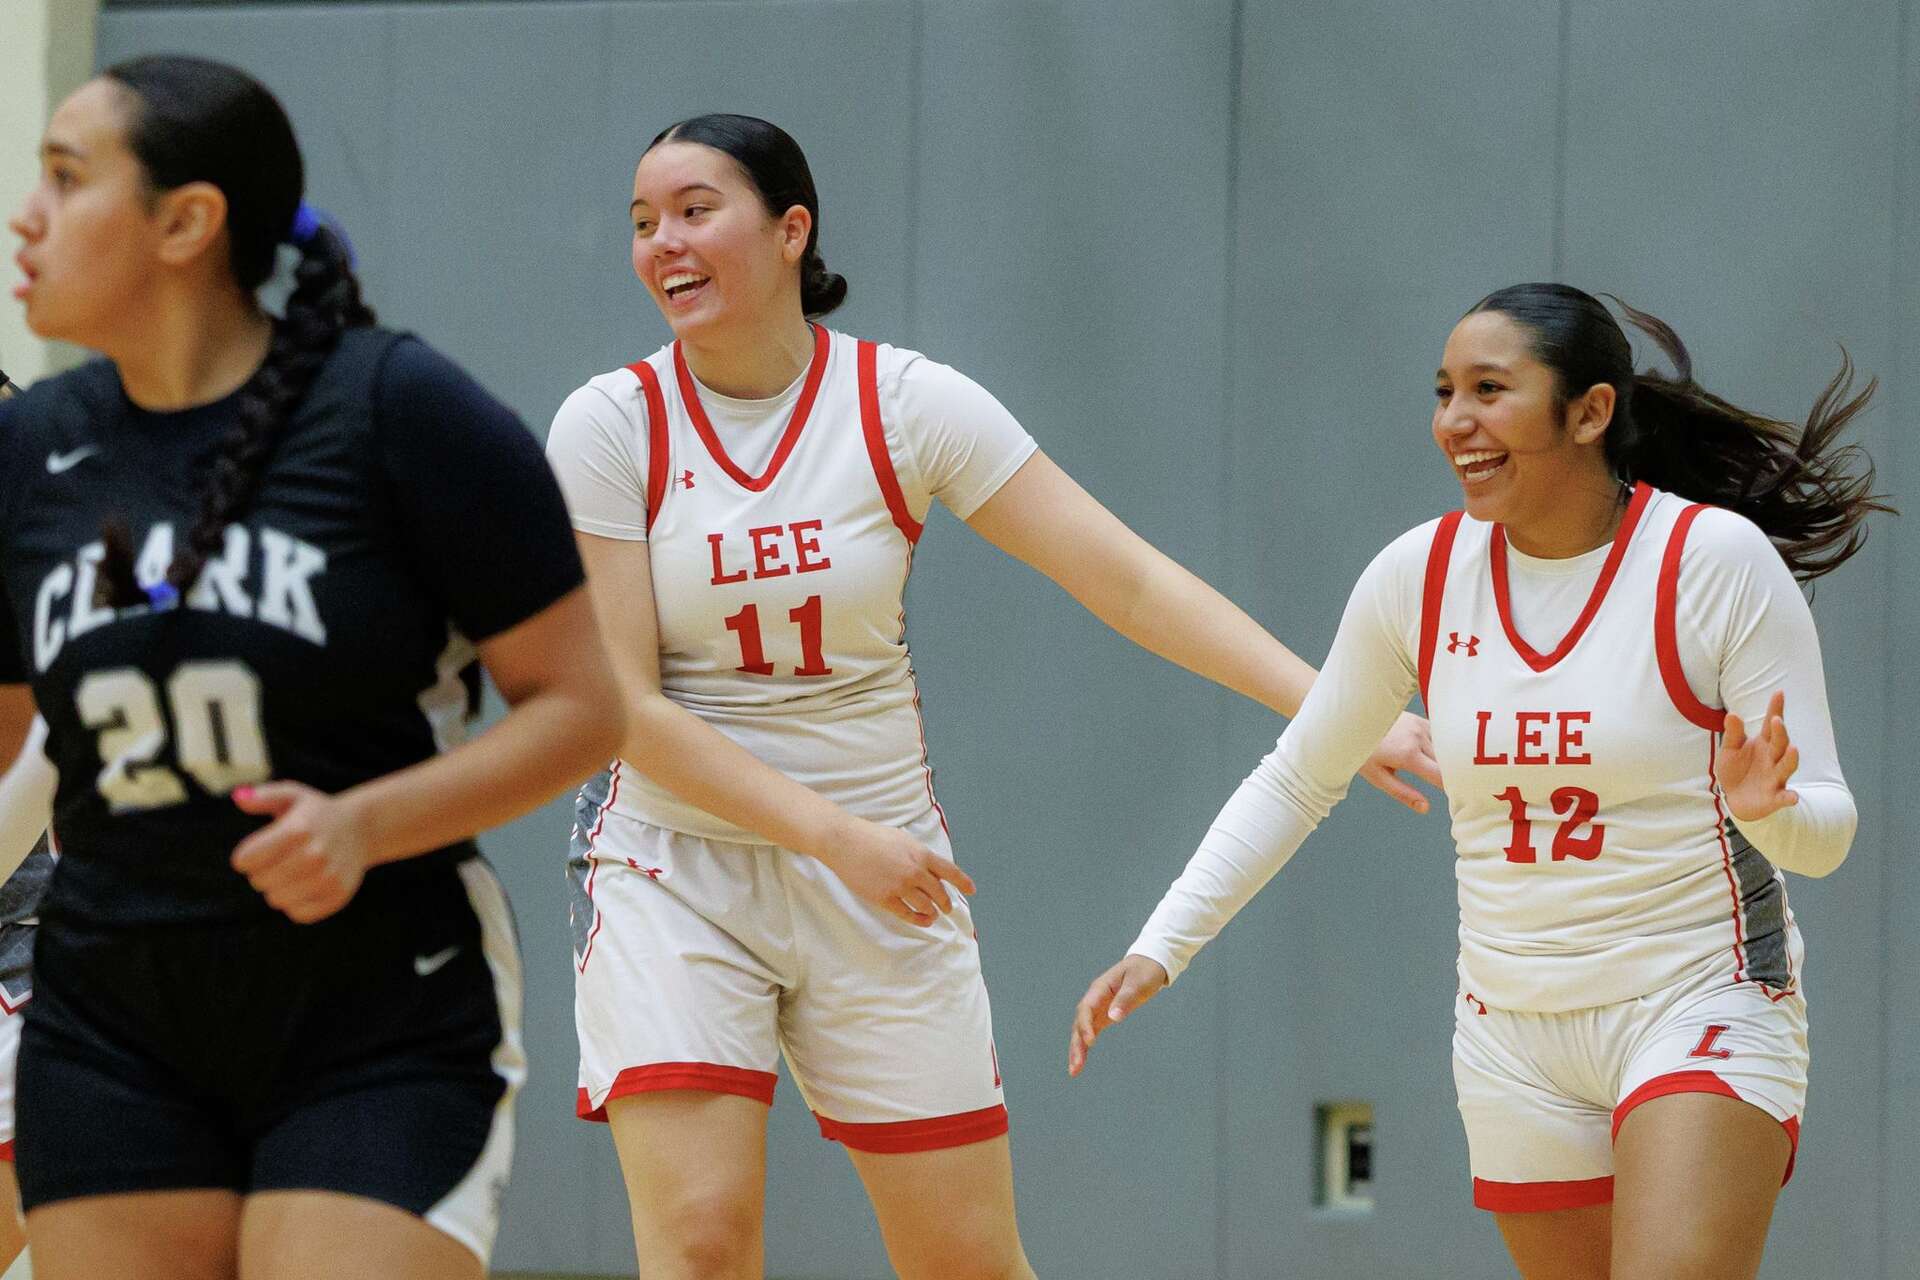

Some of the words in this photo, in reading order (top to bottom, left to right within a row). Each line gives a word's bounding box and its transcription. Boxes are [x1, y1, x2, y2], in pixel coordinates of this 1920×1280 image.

[707, 519, 831, 586] LEE
[724, 595, 832, 677] 11
[76, 659, 272, 816] 20
[1473, 711, 1592, 766] LEE
[1492, 785, 1605, 864] 12
[1687, 1024, 1734, 1061] L
